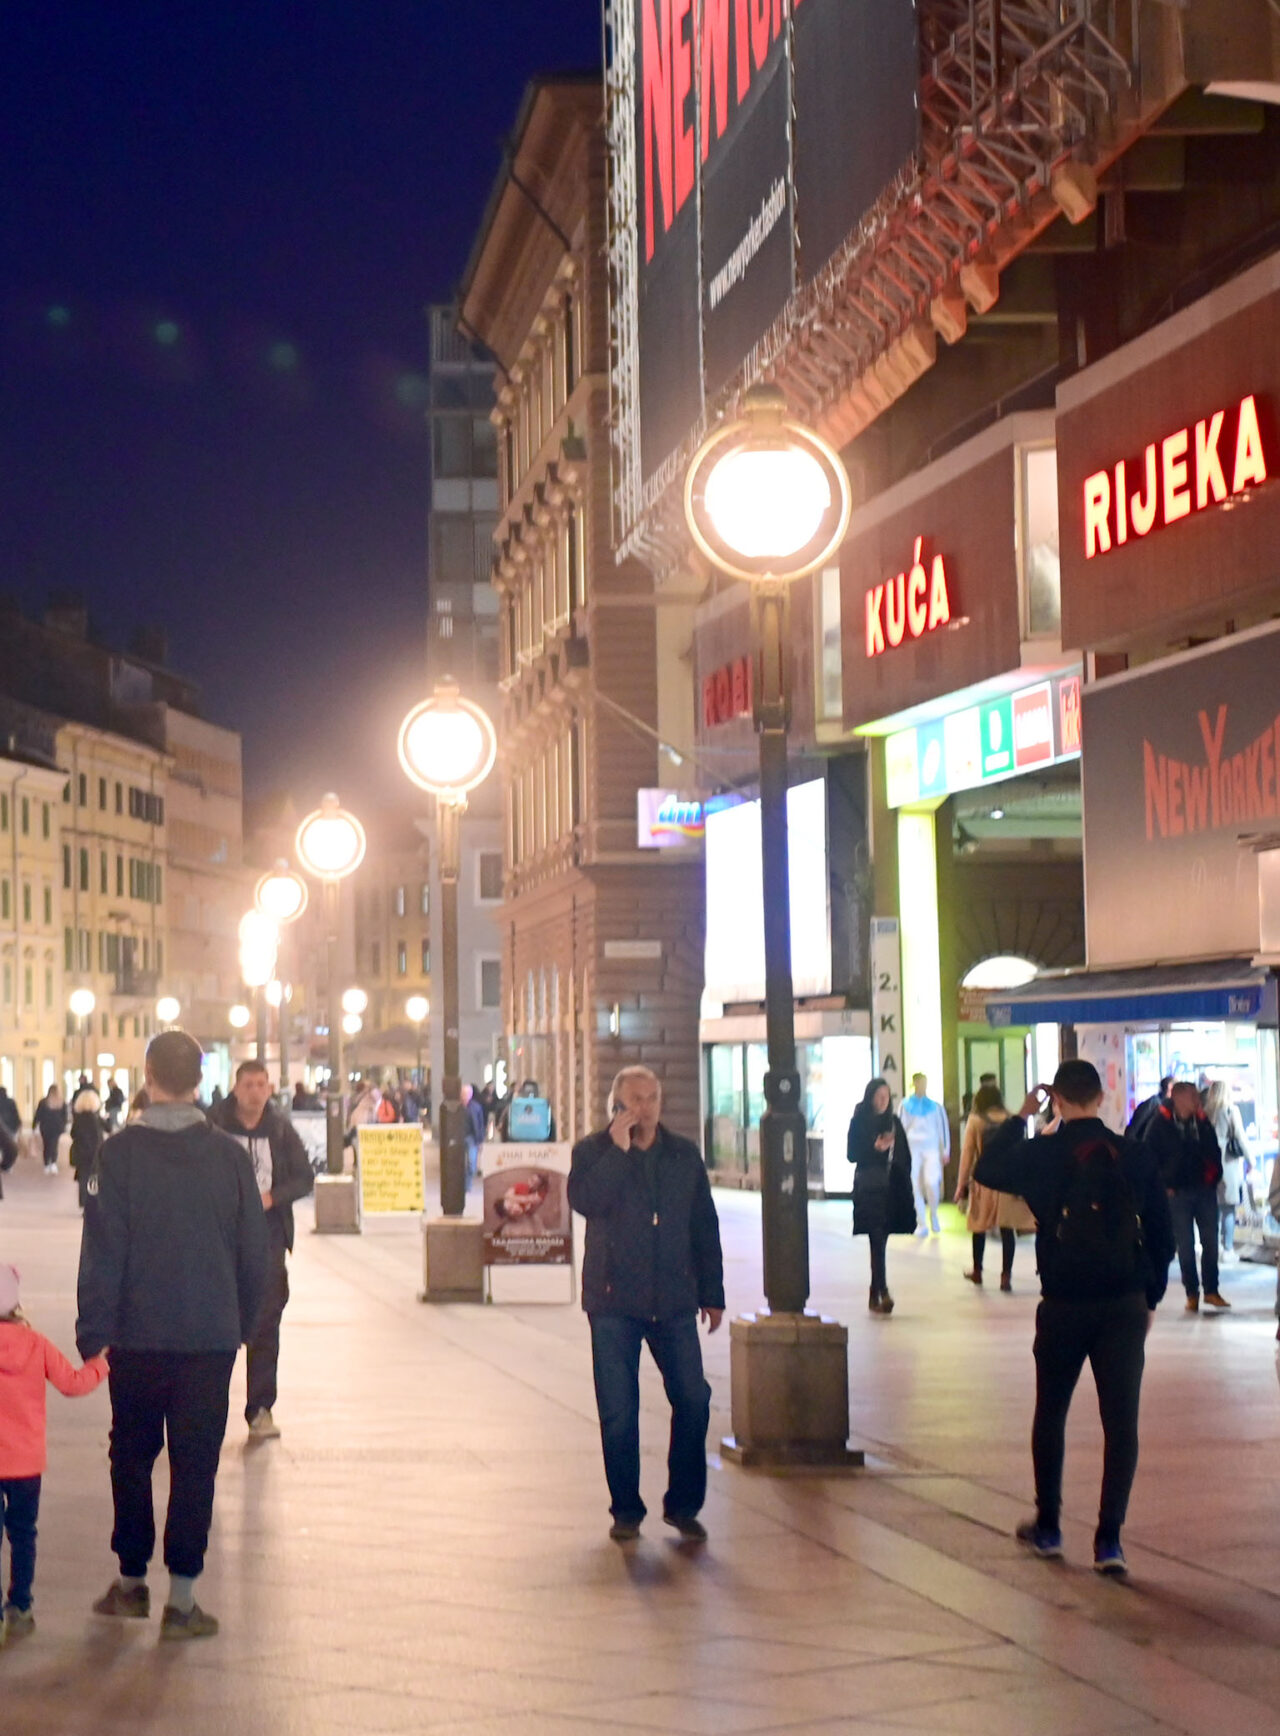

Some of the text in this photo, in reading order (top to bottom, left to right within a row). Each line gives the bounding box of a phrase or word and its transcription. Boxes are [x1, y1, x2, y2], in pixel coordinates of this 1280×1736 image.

[1082, 393, 1267, 560] RIJEKA
[865, 536, 950, 657] KUĆA
[657, 793, 703, 824] dm
